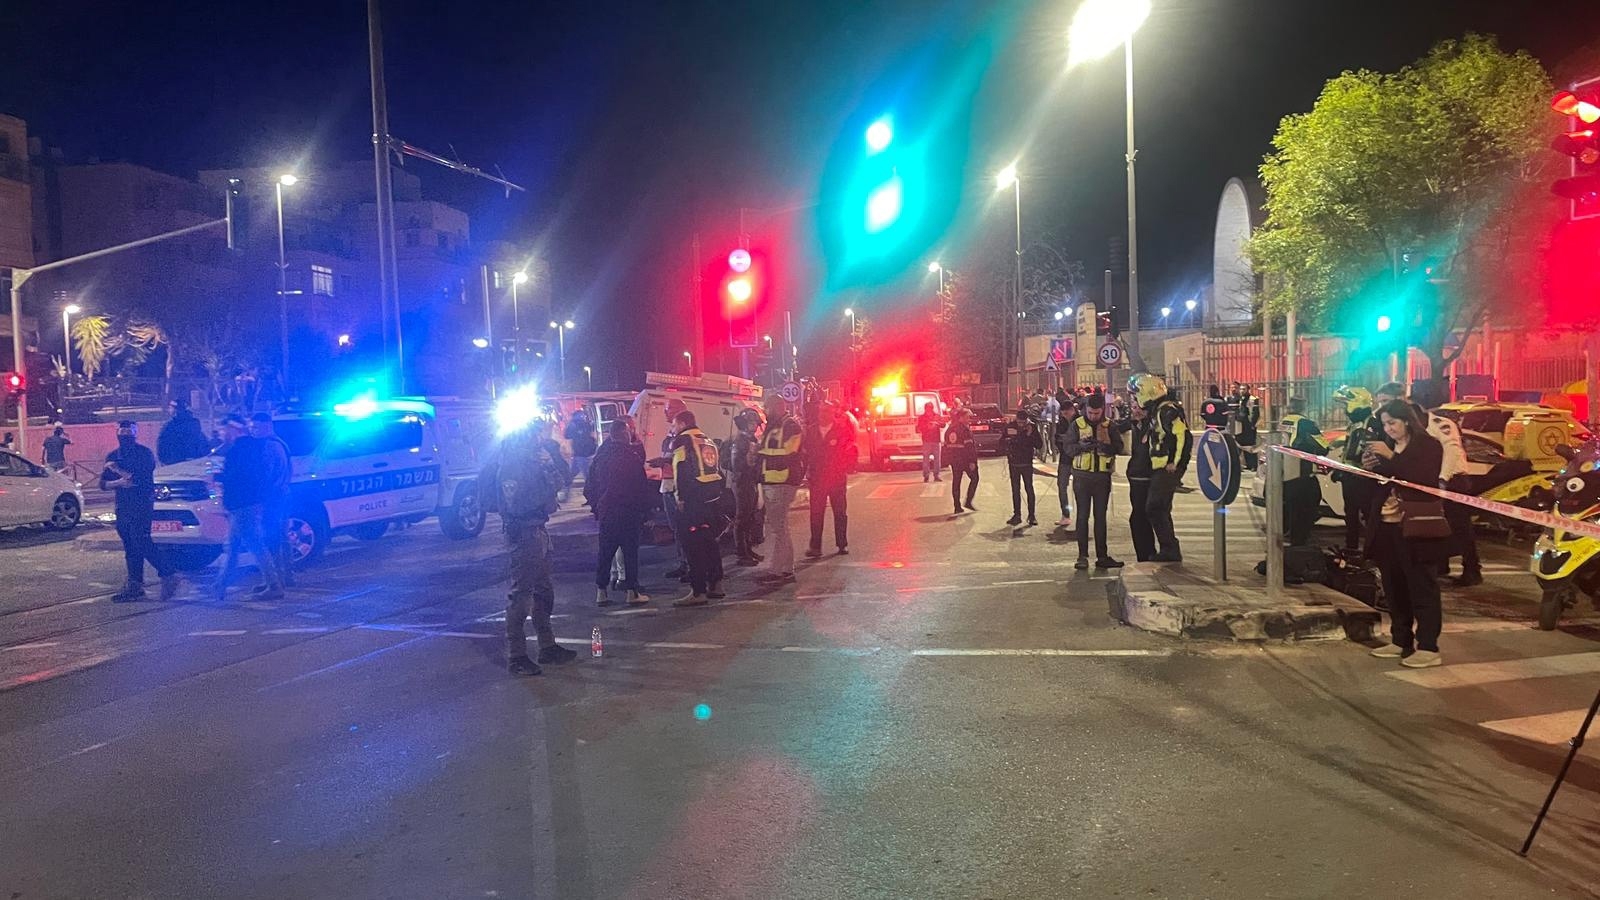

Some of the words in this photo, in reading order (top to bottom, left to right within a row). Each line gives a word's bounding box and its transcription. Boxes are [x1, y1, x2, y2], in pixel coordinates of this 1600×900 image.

[1102, 348, 1118, 360] 30
[784, 387, 799, 398] 30
[396, 470, 434, 486] משמר
[341, 476, 384, 494] הגבול
[359, 500, 388, 511] POLICE
